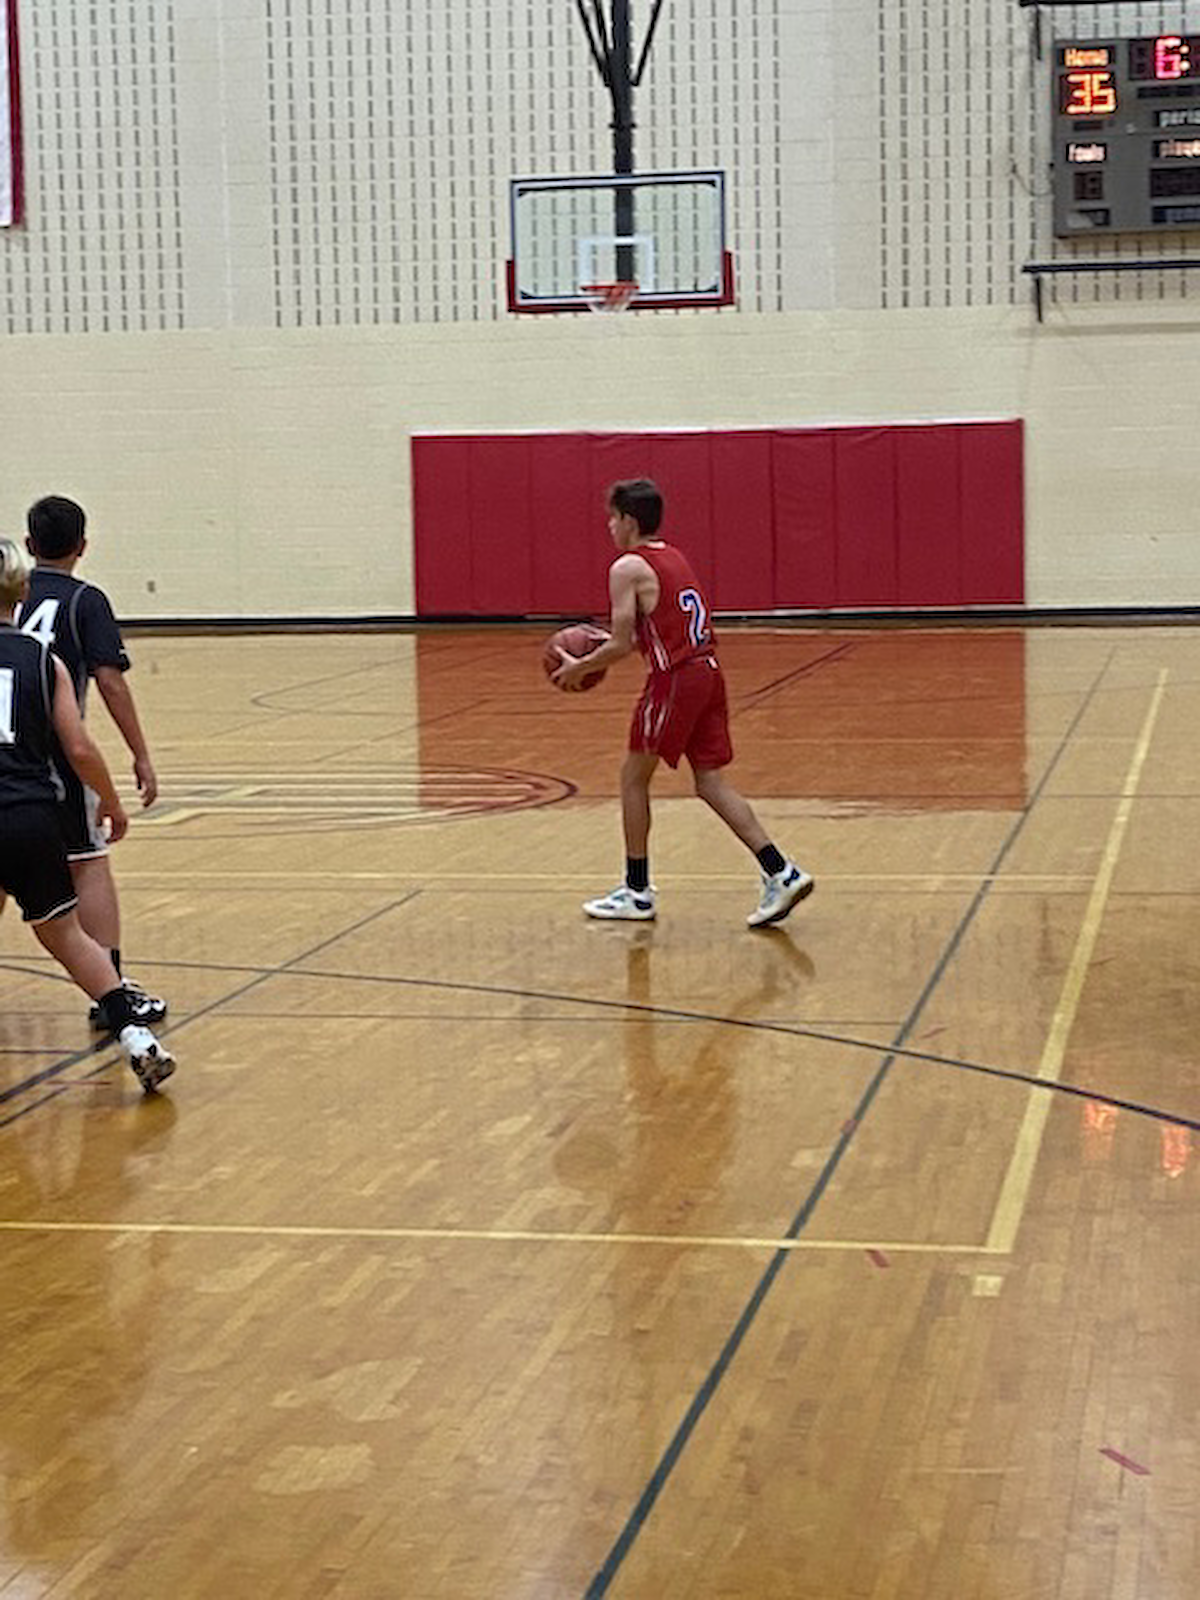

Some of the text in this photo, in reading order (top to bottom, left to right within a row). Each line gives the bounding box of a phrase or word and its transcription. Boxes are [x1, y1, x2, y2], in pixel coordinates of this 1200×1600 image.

[1065, 48, 1109, 67] Home
[1066, 72, 1116, 114] 35
[679, 588, 710, 648] 2
